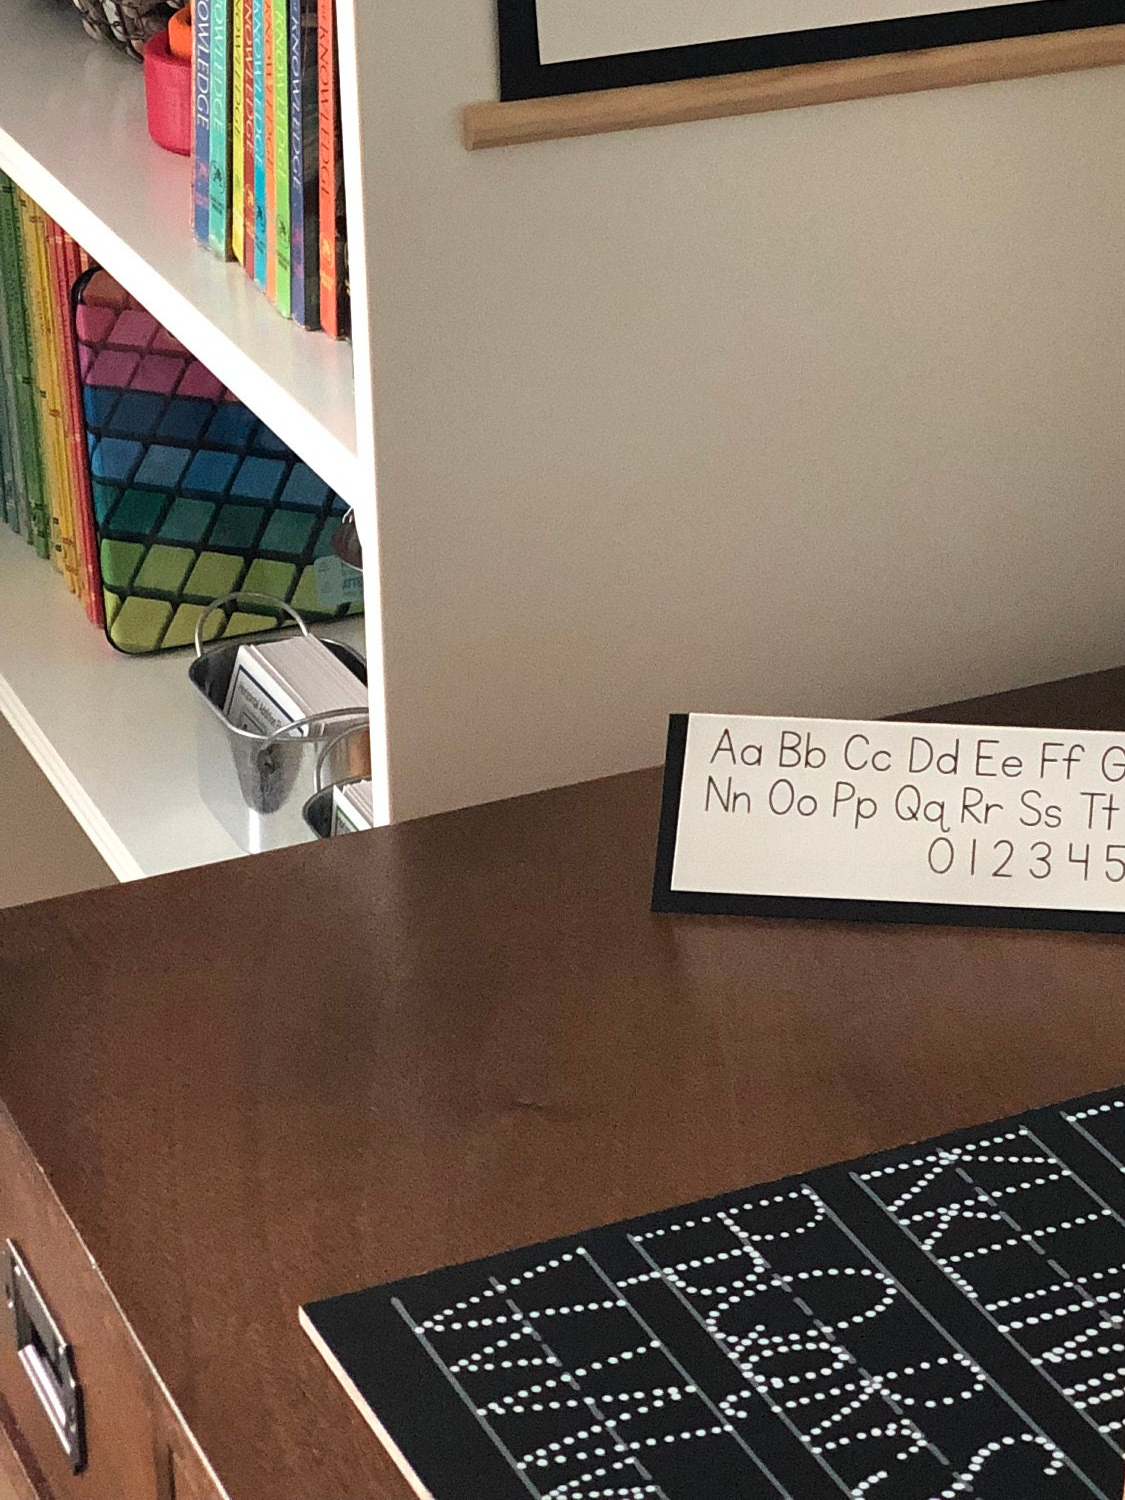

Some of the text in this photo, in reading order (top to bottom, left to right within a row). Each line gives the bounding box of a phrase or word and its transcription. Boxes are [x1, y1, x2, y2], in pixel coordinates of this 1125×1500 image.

[254, 0, 263, 170] KNOWLEDGE
[265, 1, 274, 174] KNOWLEDGE
[275, 10, 286, 184] KNOWLEDGE
[291, 15, 301, 192] KNOWLEDGE
[319, 25, 331, 200] KNOWLEDGE
[705, 775, 751, 814] Nn
[769, 779, 817, 816] Oo
[833, 781, 877, 829] Pp
[895, 784, 951, 833] Qq
[961, 787, 1004, 824] Rr
[1020, 790, 1062, 828] Ss
[1080, 792, 1120, 831] Tt
[709, 728, 762, 766] Aa
[779, 731, 826, 769] Bb
[844, 734, 891, 771] Cc
[909, 737, 959, 775] Dd
[975, 739, 1023, 777] Ee
[1040, 742, 1085, 780] Ff
